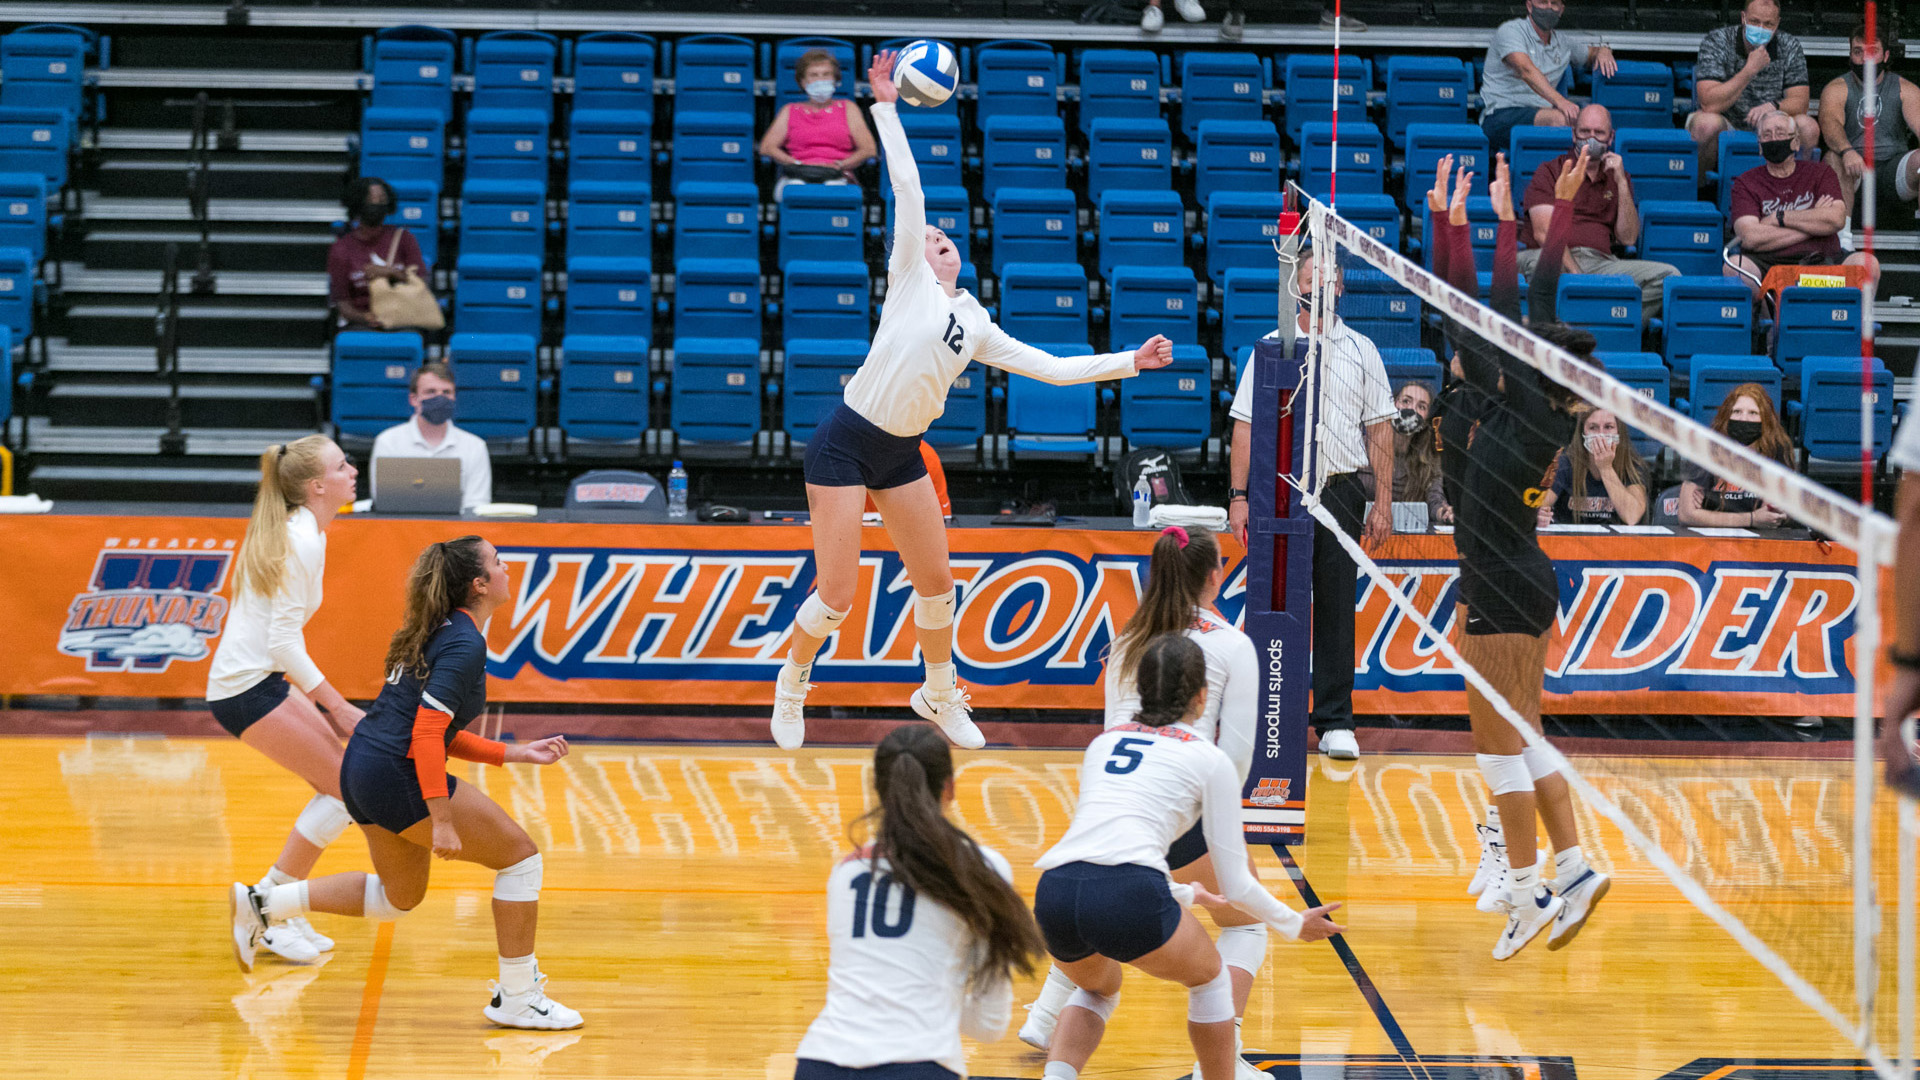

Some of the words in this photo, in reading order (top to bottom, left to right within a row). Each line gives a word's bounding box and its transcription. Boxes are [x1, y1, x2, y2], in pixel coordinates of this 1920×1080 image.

[943, 312, 964, 356] 12
[104, 537, 237, 549] WHEATON
[66, 594, 226, 635] THUNDER
[1222, 563, 1863, 678] UDER
[1267, 638, 1283, 692] sports
[1265, 694, 1281, 759] imports
[1104, 737, 1155, 775] 5
[850, 872, 916, 939] 10
